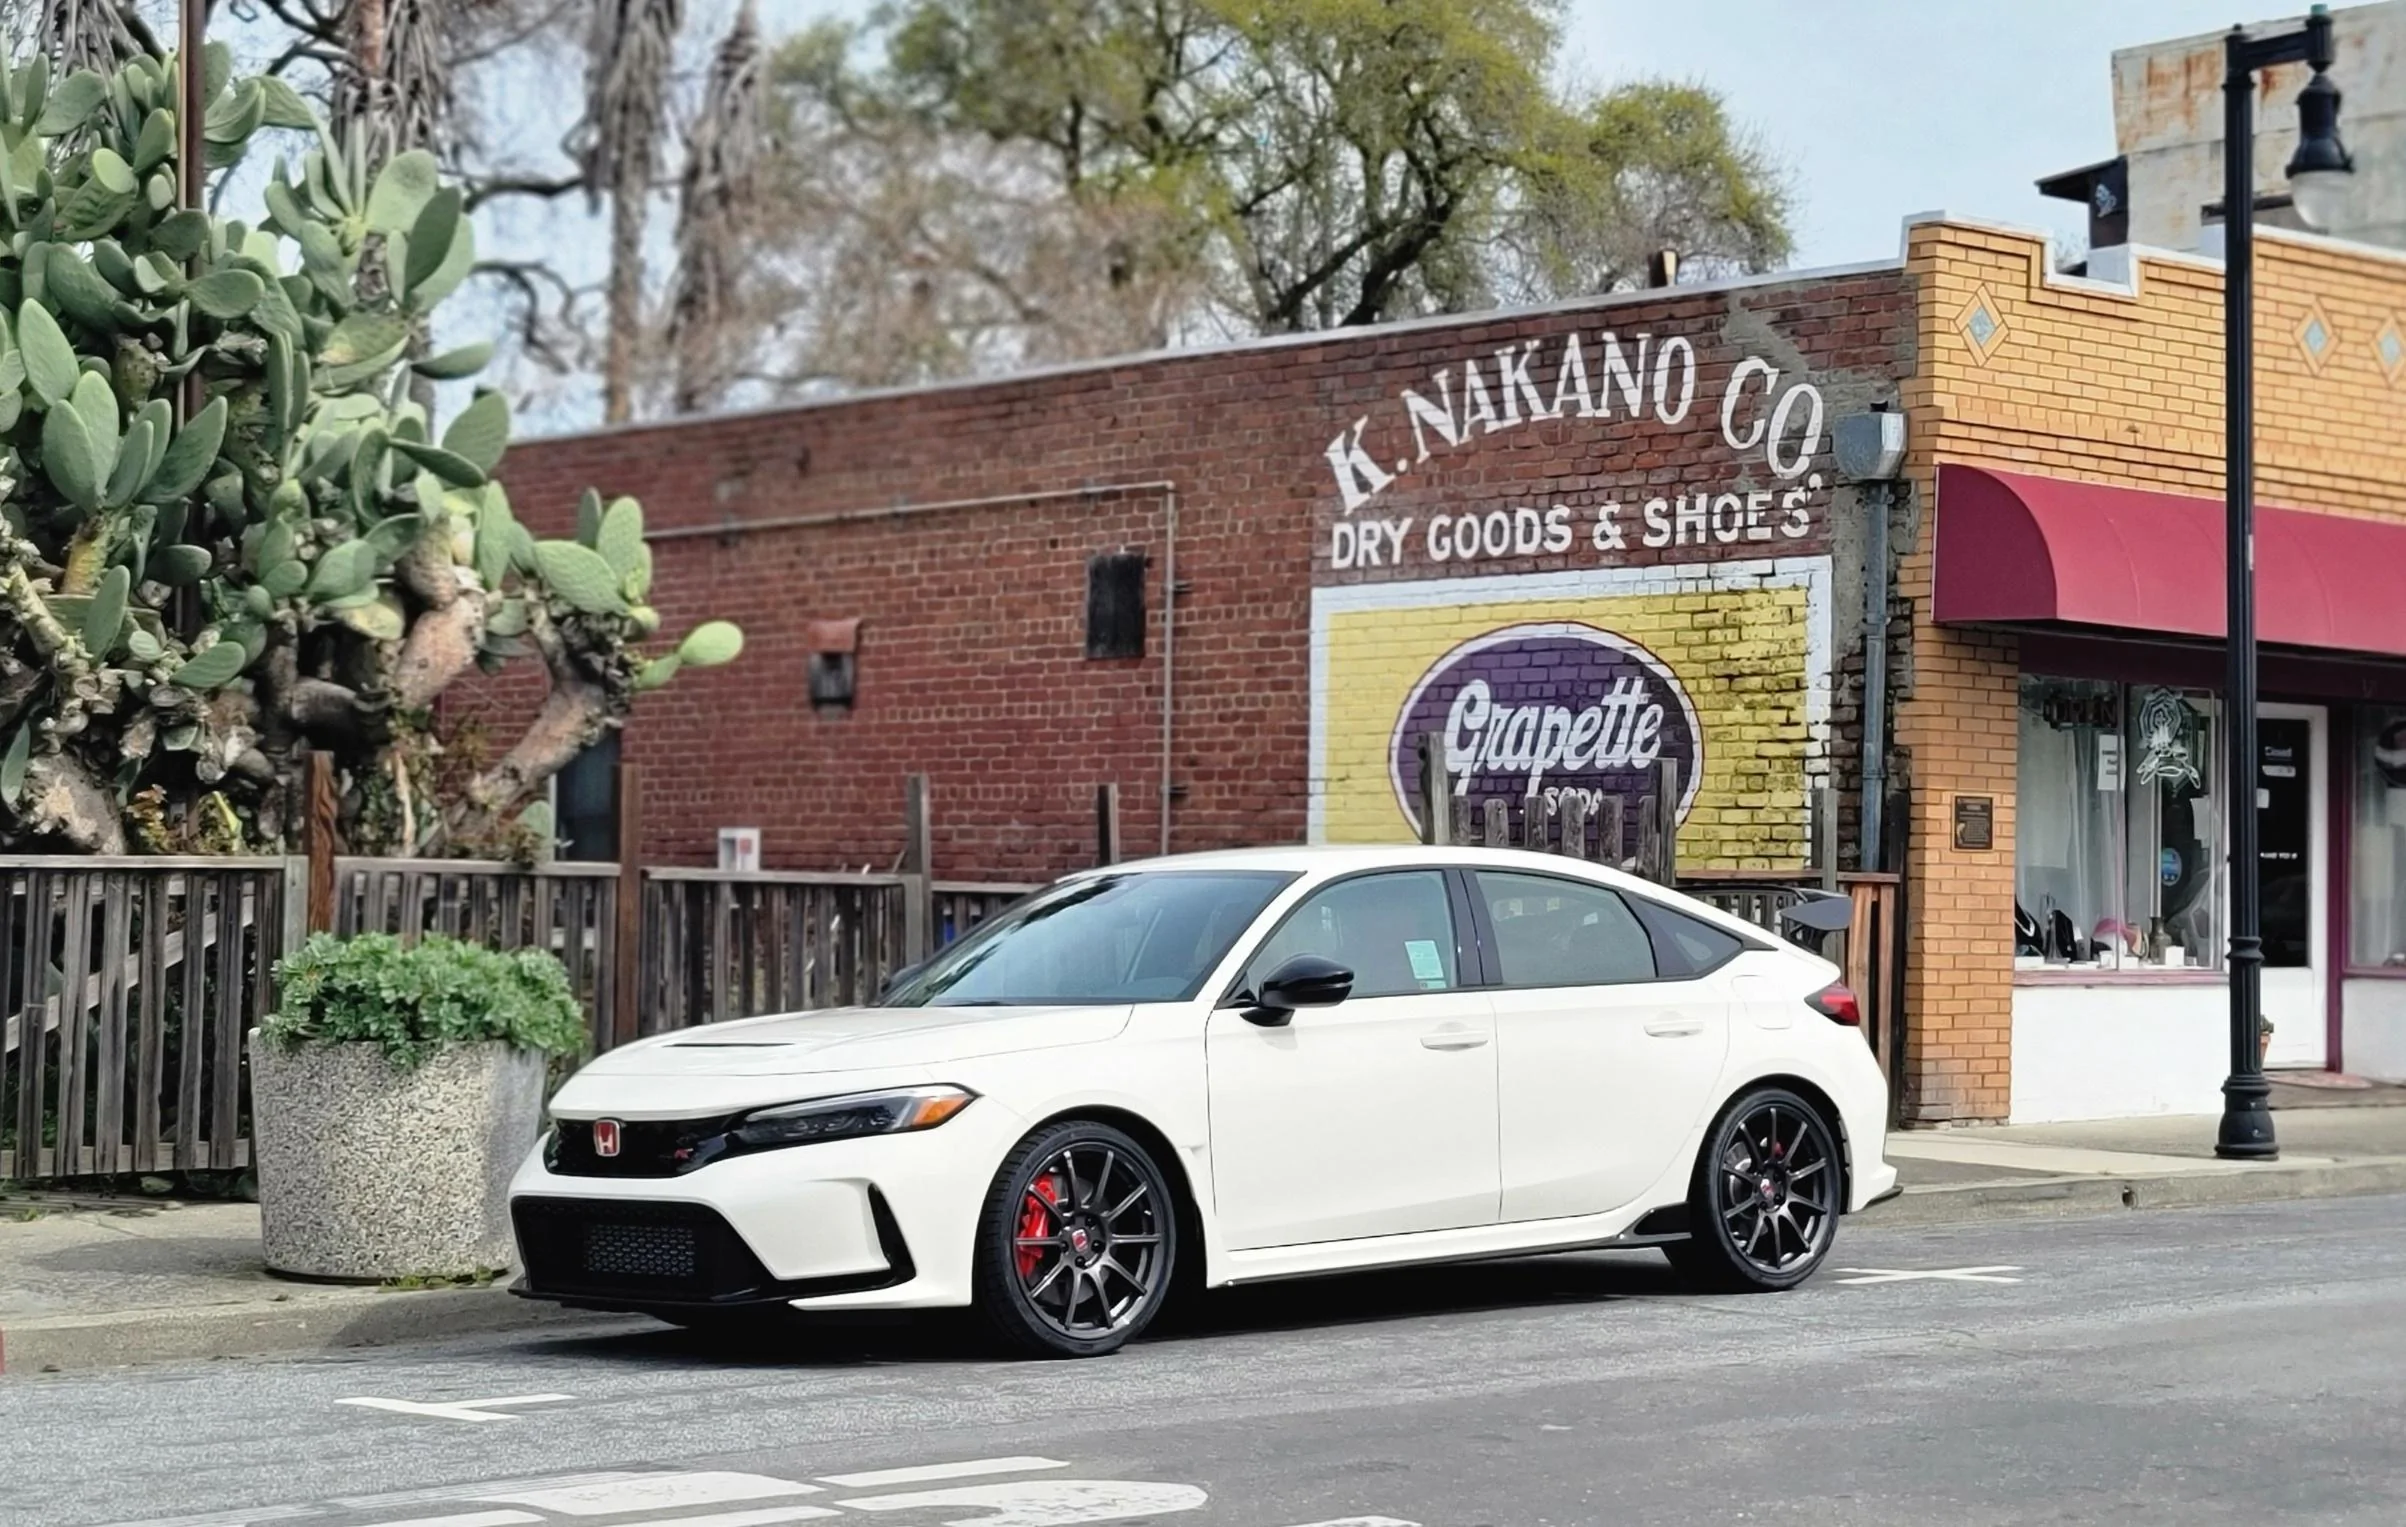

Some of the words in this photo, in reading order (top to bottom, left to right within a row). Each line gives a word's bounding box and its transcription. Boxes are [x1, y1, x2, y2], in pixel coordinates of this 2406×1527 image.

[1400, 331, 1696, 464] NAKANO
[1331, 517, 1412, 569] DRY
[1427, 504, 1573, 561] GOODS
[1592, 501, 1625, 550] &
[1642, 487, 1811, 547] SHOES
[1445, 676, 1664, 796] Grapette
